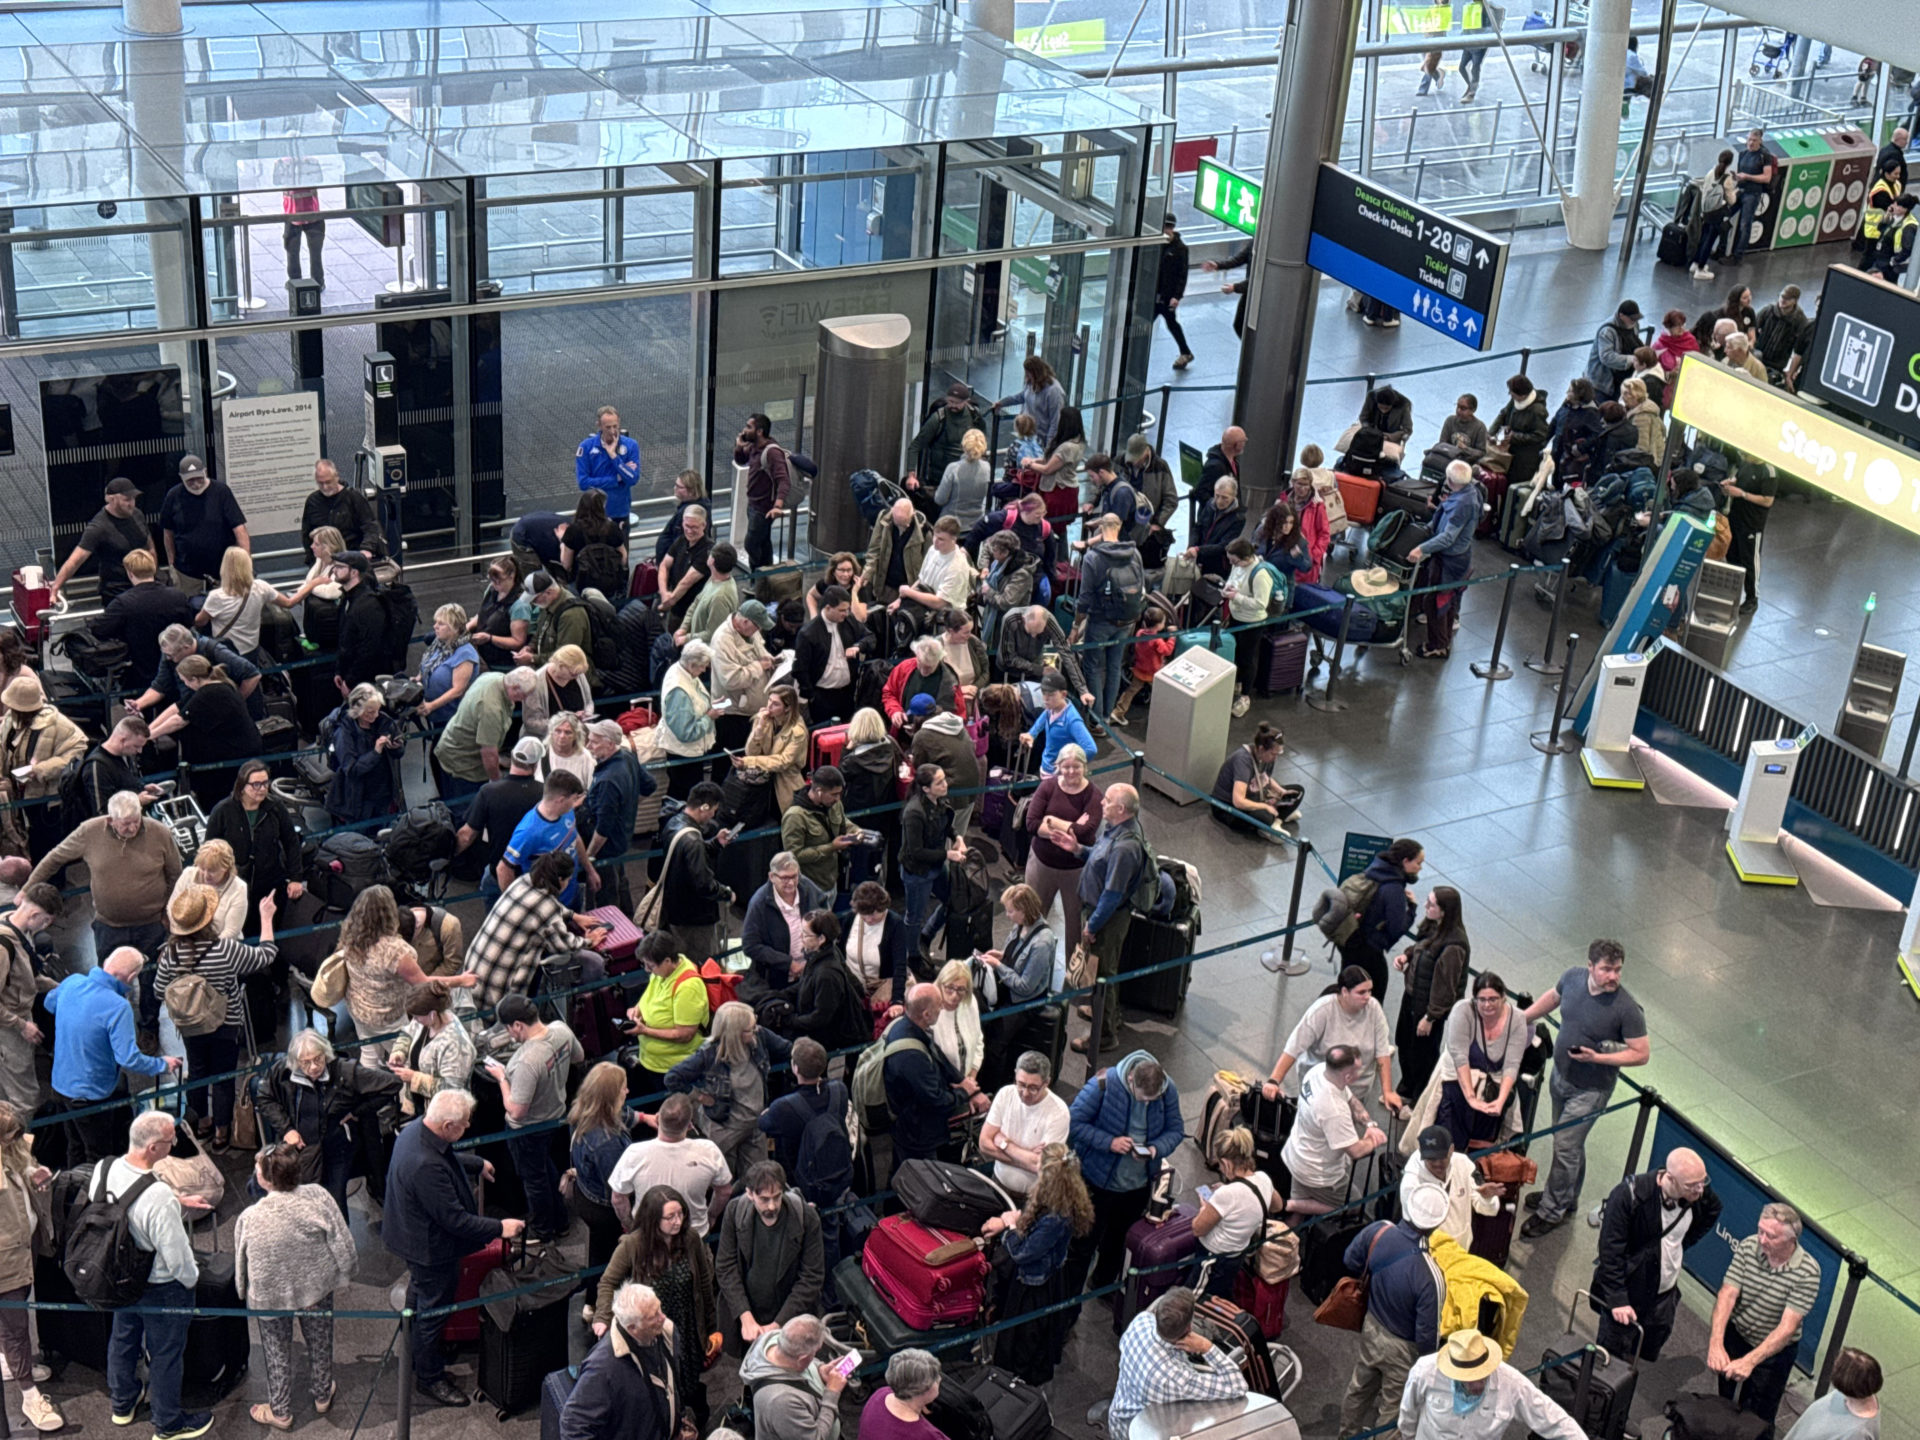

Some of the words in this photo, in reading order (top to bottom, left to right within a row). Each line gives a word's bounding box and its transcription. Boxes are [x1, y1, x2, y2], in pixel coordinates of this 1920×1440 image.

[1354, 186, 1381, 207] Deasca
[1381, 199, 1415, 223] Cláraithe
[1416, 219, 1452, 253] 1-28
[1358, 204, 1390, 227] Check-in
[1390, 220, 1413, 238] Desks
[1418, 268, 1445, 290] Tickets
[1425, 254, 1448, 274] Ticéid
[229, 410, 255, 419] Airport
[295, 404, 312, 412] 2014
[1778, 420, 1837, 476] Step
[1843, 451, 1857, 482] 1
[1715, 1222, 1741, 1253] Ling
